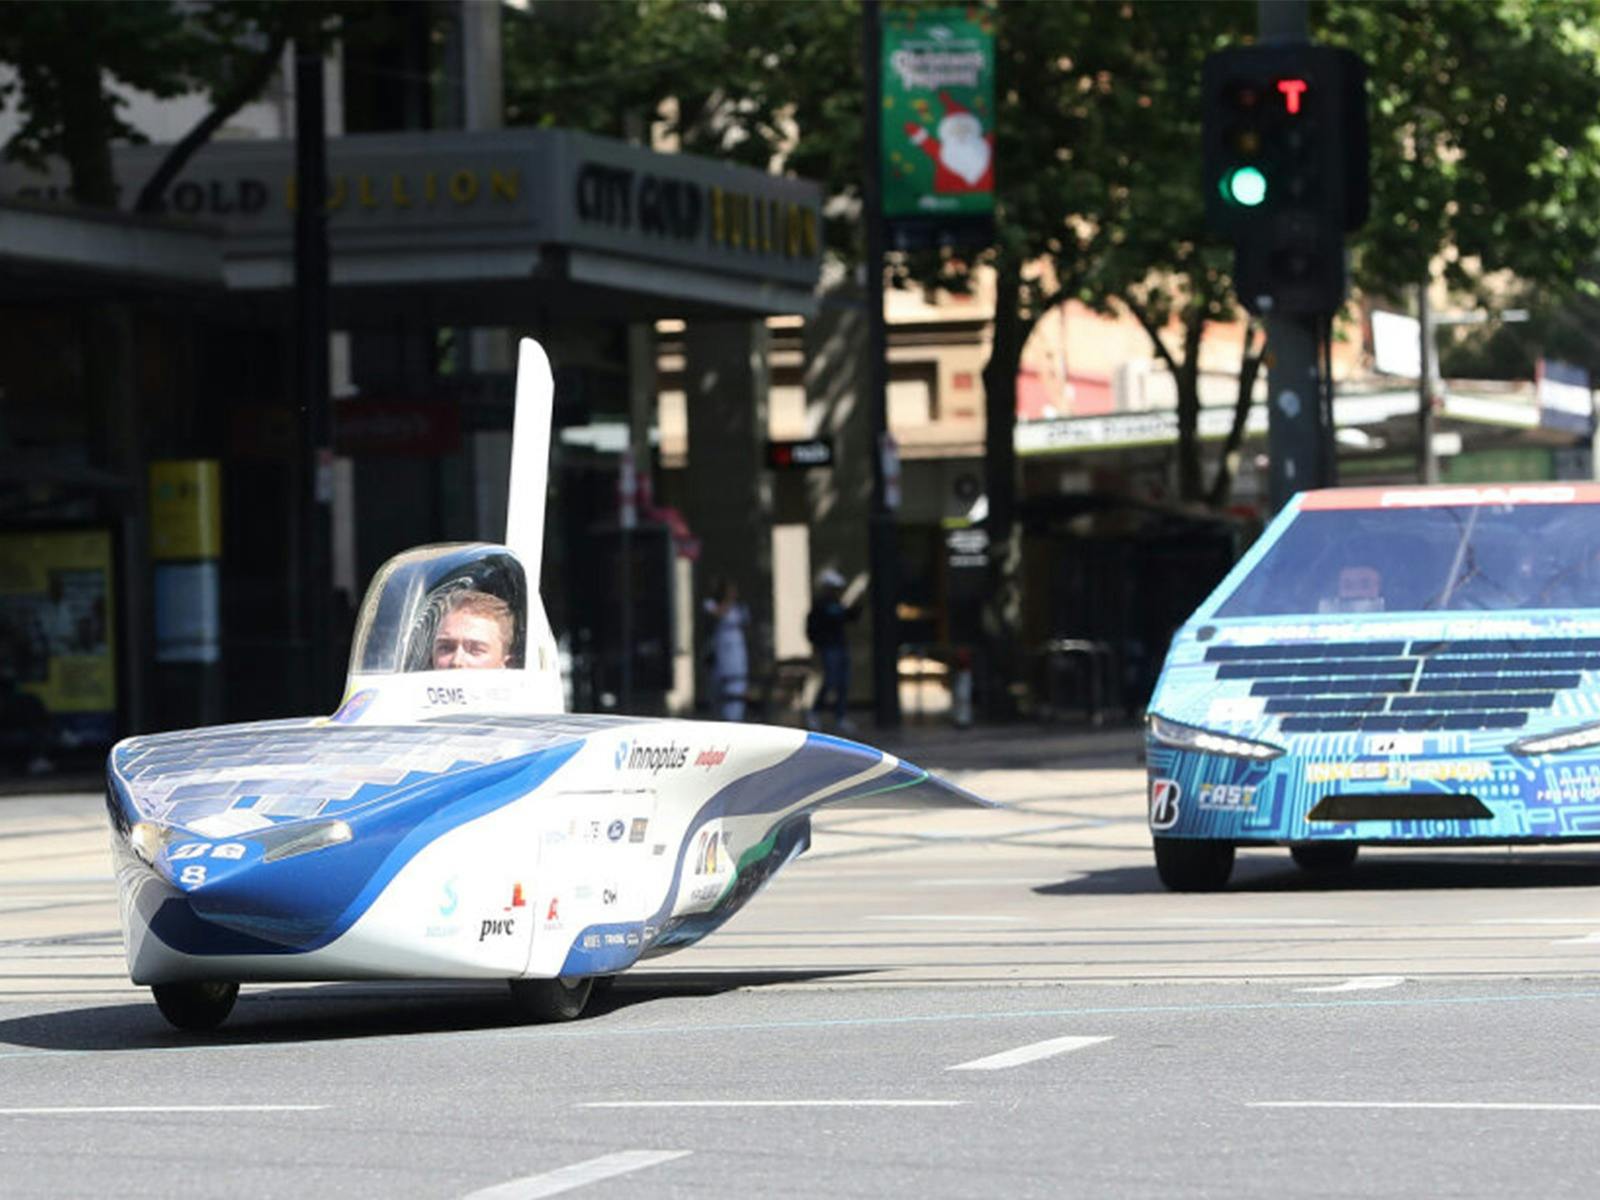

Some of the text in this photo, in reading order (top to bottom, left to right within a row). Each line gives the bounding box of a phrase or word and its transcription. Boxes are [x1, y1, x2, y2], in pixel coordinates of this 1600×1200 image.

[427, 687, 467, 705] DEME
[628, 738, 690, 776] innoptus
[1199, 784, 1258, 806] FAST
[180, 865, 208, 885] 8
[479, 917, 515, 943] pwc
